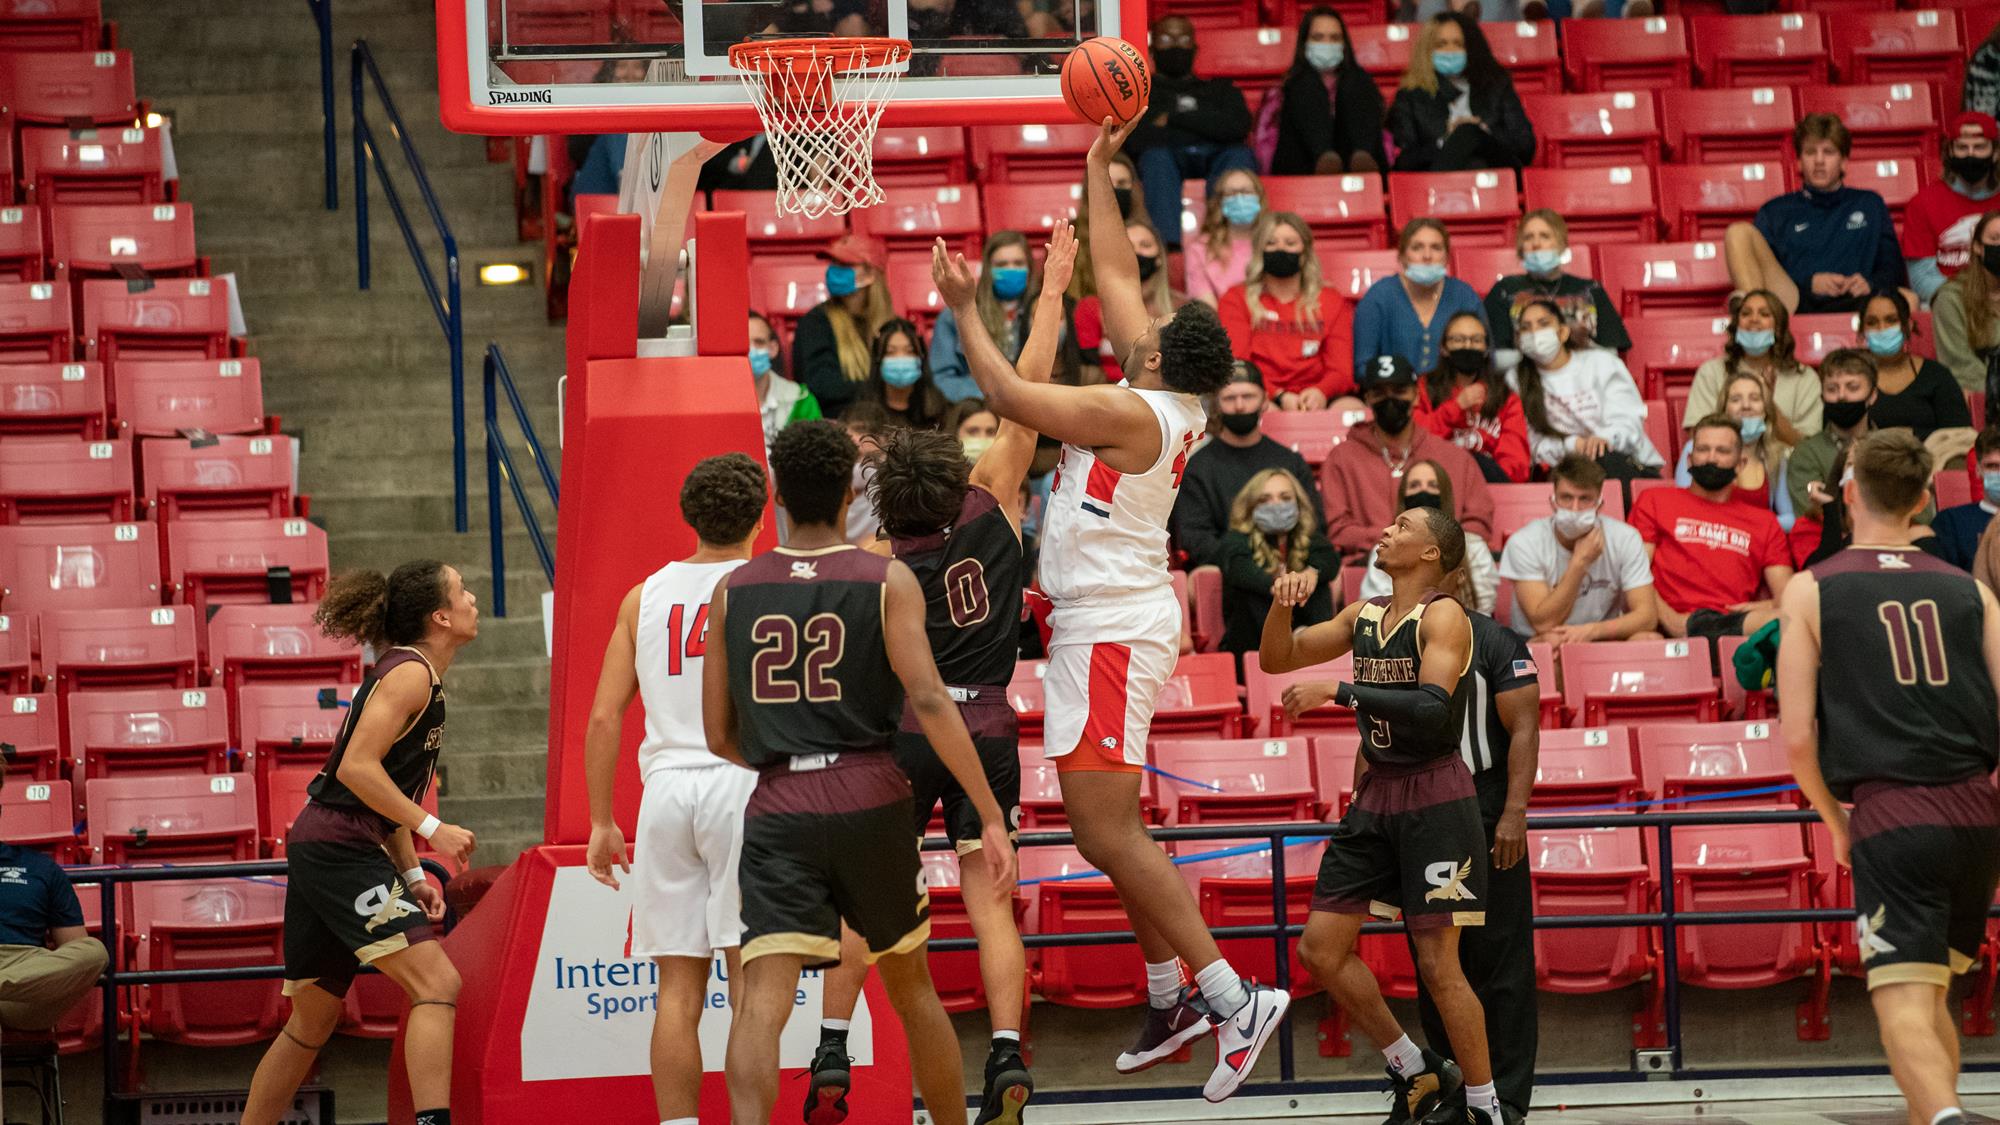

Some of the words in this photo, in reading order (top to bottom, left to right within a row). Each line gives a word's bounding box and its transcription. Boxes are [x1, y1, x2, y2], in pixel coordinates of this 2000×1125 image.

[1103, 58, 1134, 102] NCAA
[488, 89, 552, 105] SPALDING
[1377, 355, 1395, 378] 3
[120, 526, 133, 540] 13
[1698, 525, 1729, 545] GAME
[1730, 531, 1751, 552] DAY
[944, 557, 990, 628] 0
[1877, 600, 1949, 686] 11
[751, 612, 846, 704] 22
[188, 693, 201, 706] 12
[32, 786, 46, 800] 10
[587, 992, 657, 1019] Sport
